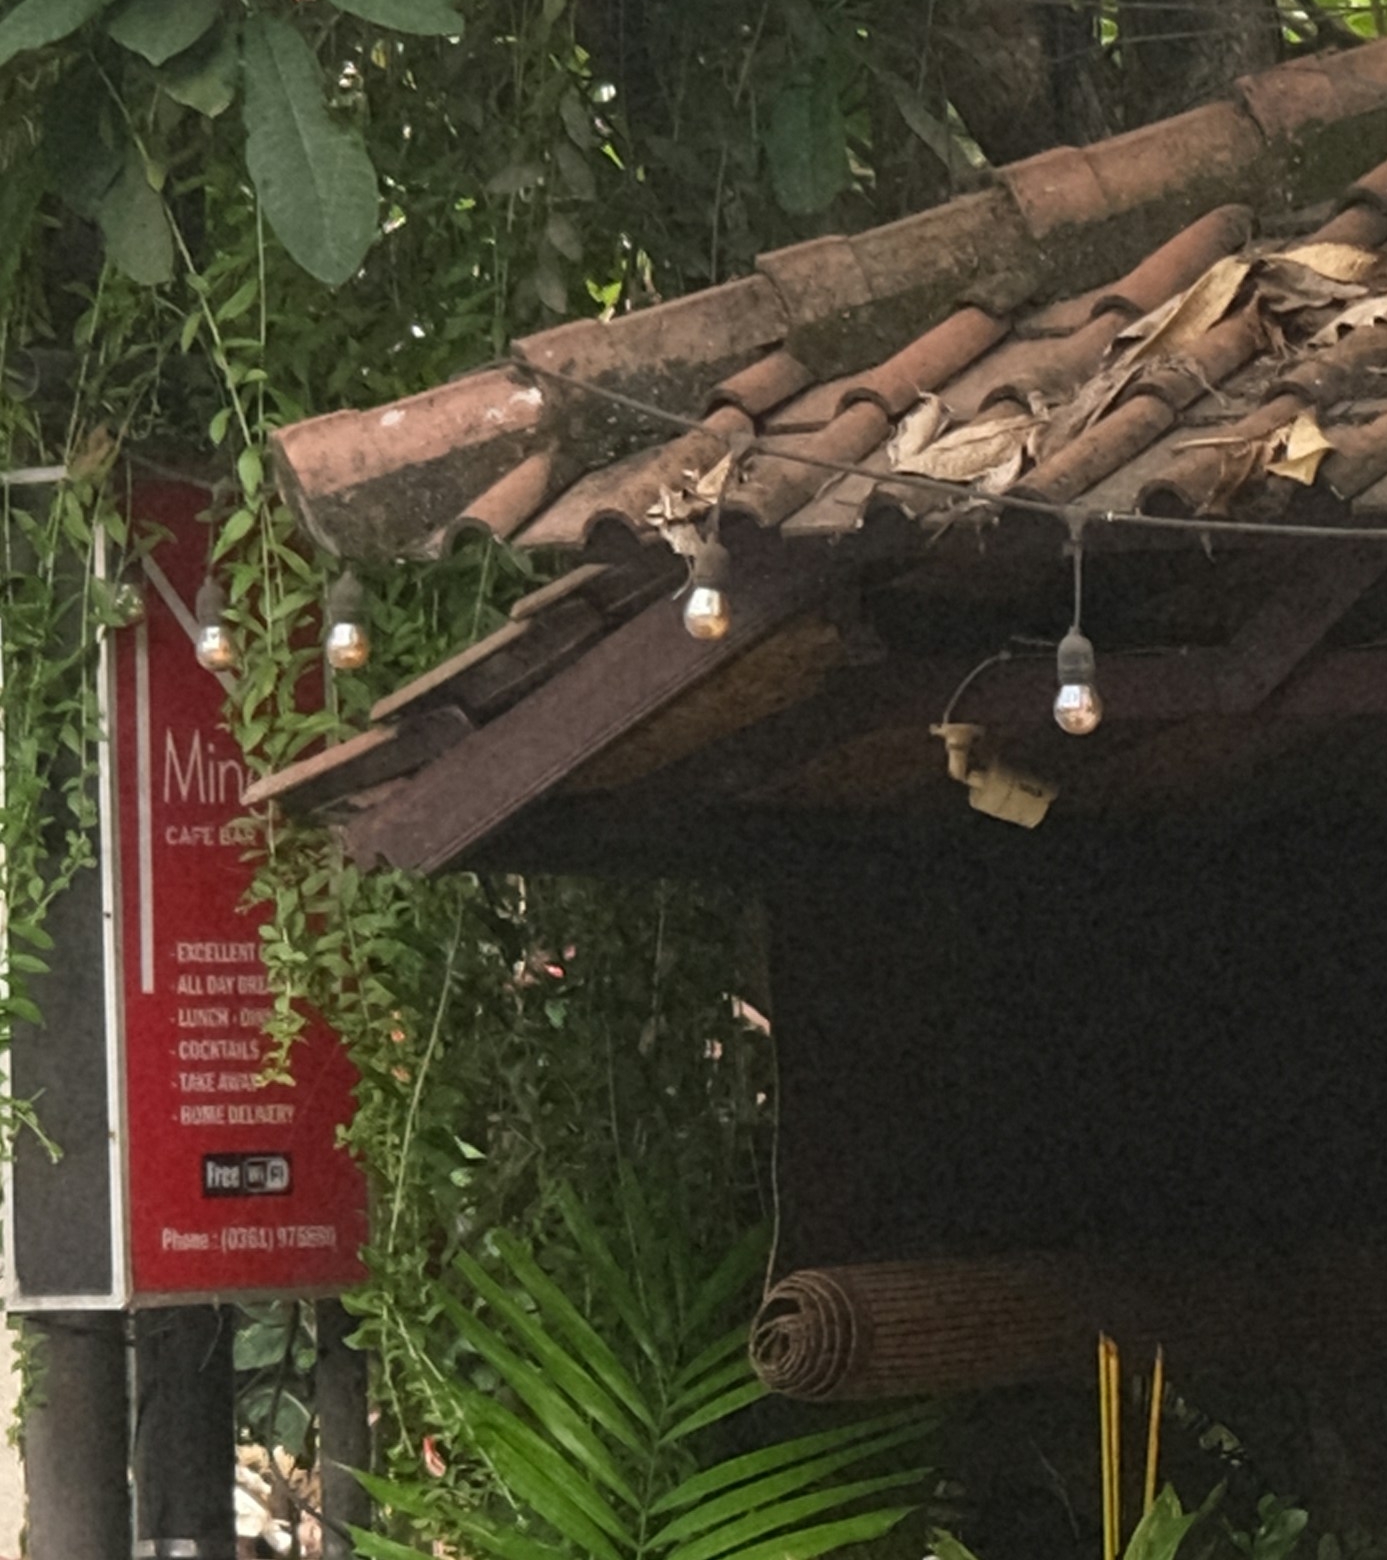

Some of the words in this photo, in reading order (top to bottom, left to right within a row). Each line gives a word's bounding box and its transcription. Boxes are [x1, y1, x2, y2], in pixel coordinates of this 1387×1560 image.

[166, 826, 214, 846] CAFE
[177, 975, 202, 994] ALL
[207, 976, 234, 994] DAY
[178, 1009, 230, 1027] LUNCH
[178, 1041, 260, 1060] COCKTAILS
[206, 1161, 240, 1188] Free
